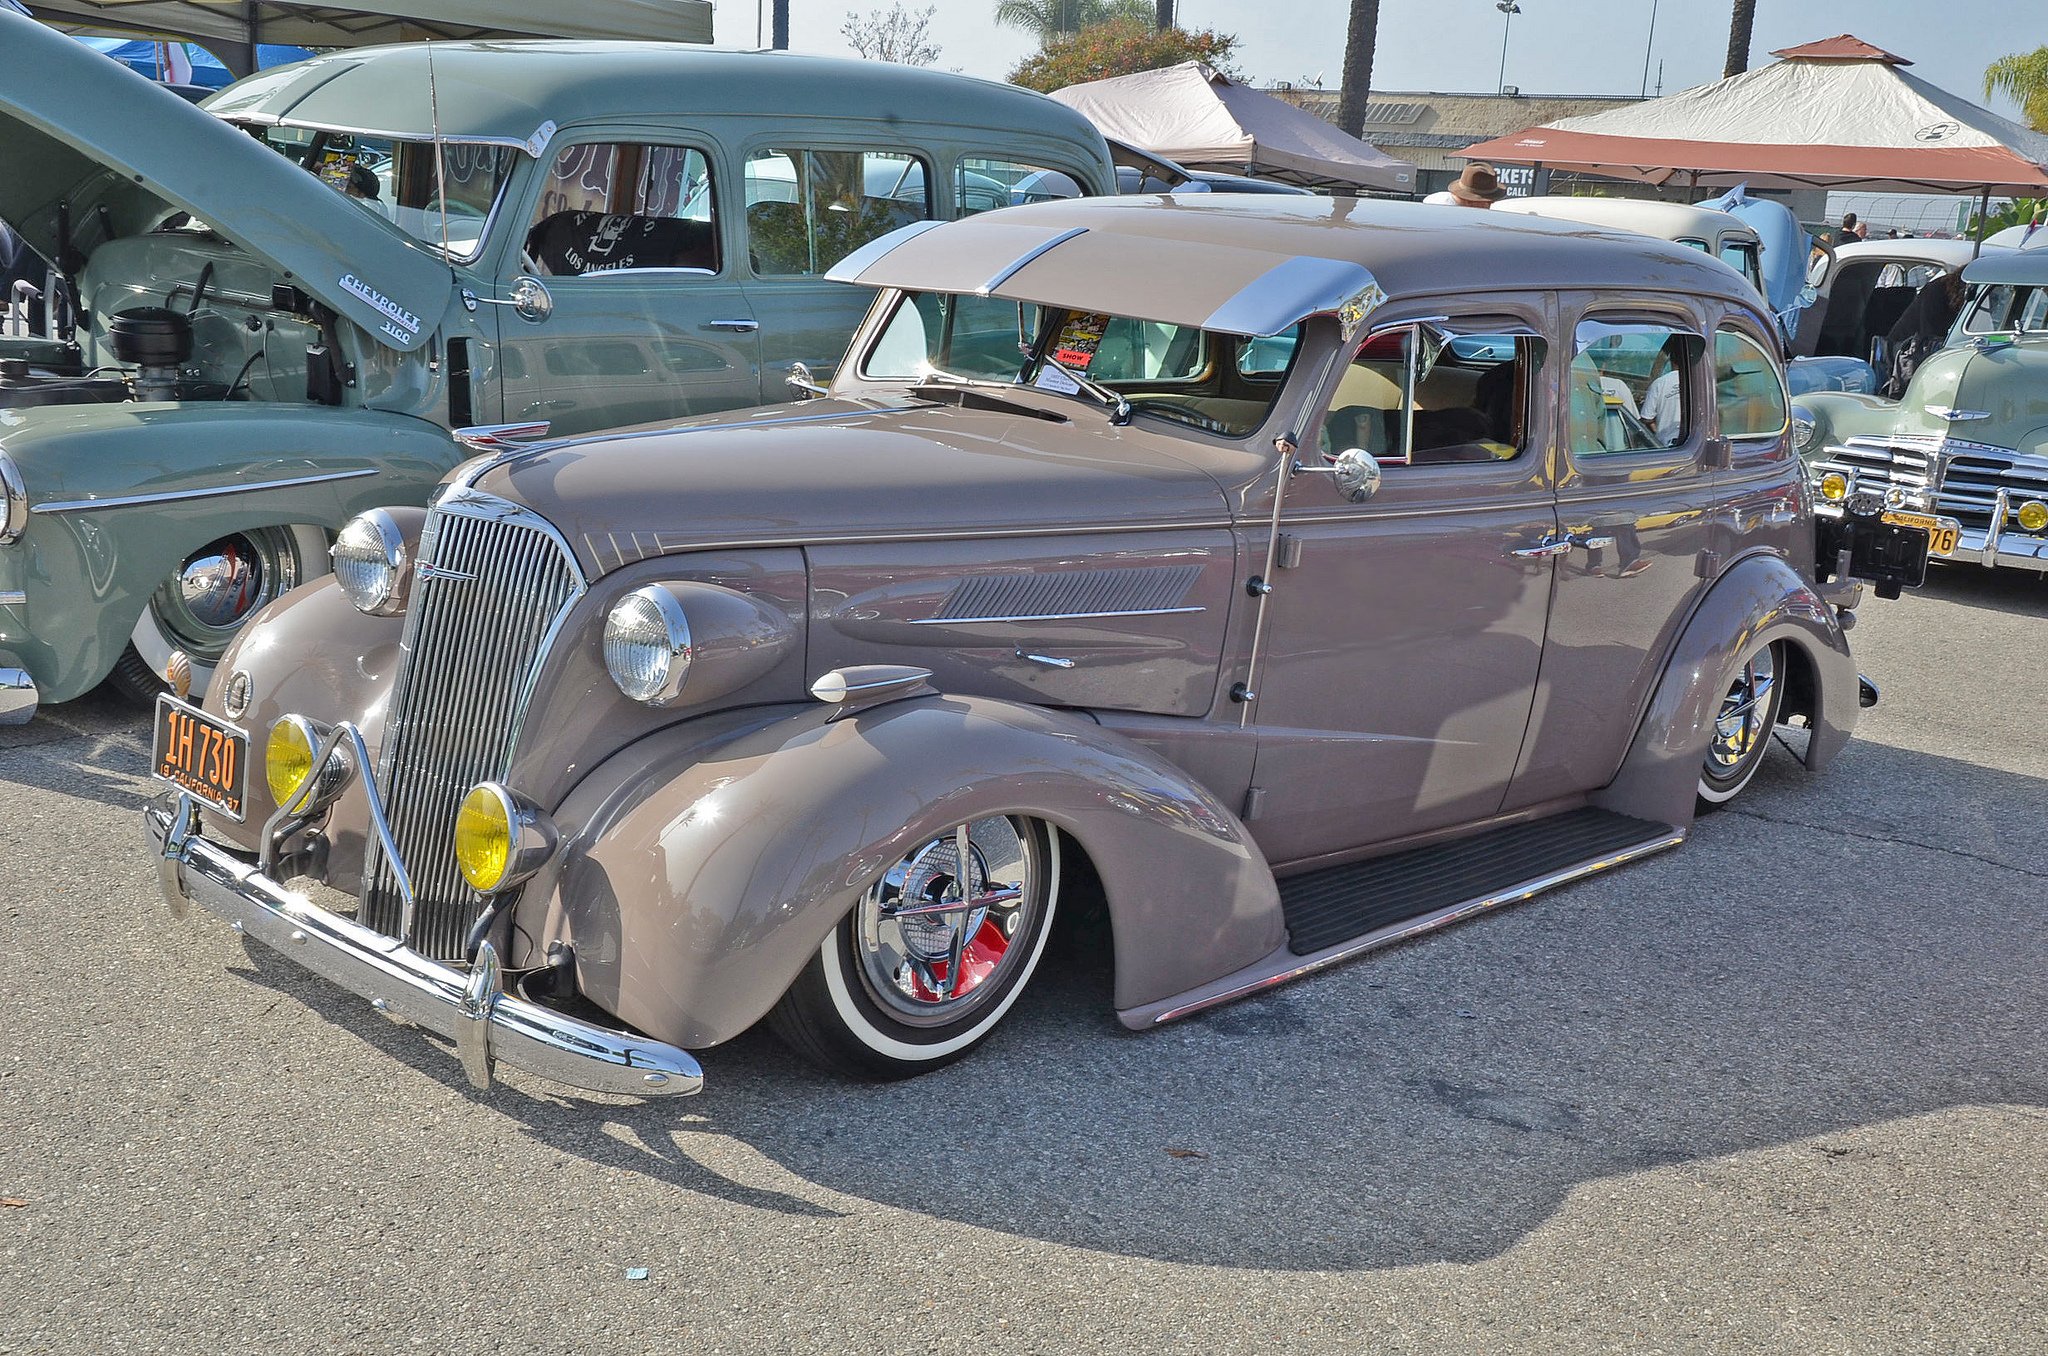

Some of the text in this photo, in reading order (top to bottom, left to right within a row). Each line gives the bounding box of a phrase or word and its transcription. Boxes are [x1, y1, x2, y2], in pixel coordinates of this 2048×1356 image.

[1506, 186, 1528, 197] CALL
[564, 247, 583, 270] LOS
[344, 274, 421, 328] CHEVROLET
[384, 321, 411, 342] 3100
[1062, 353, 1084, 361] SHOW
[1895, 514, 1937, 526] CALIFORNIA
[1930, 528, 1954, 551] 76
[165, 711, 235, 792] 1H 730
[160, 763, 240, 811] 19 CALIFORNIA 37
